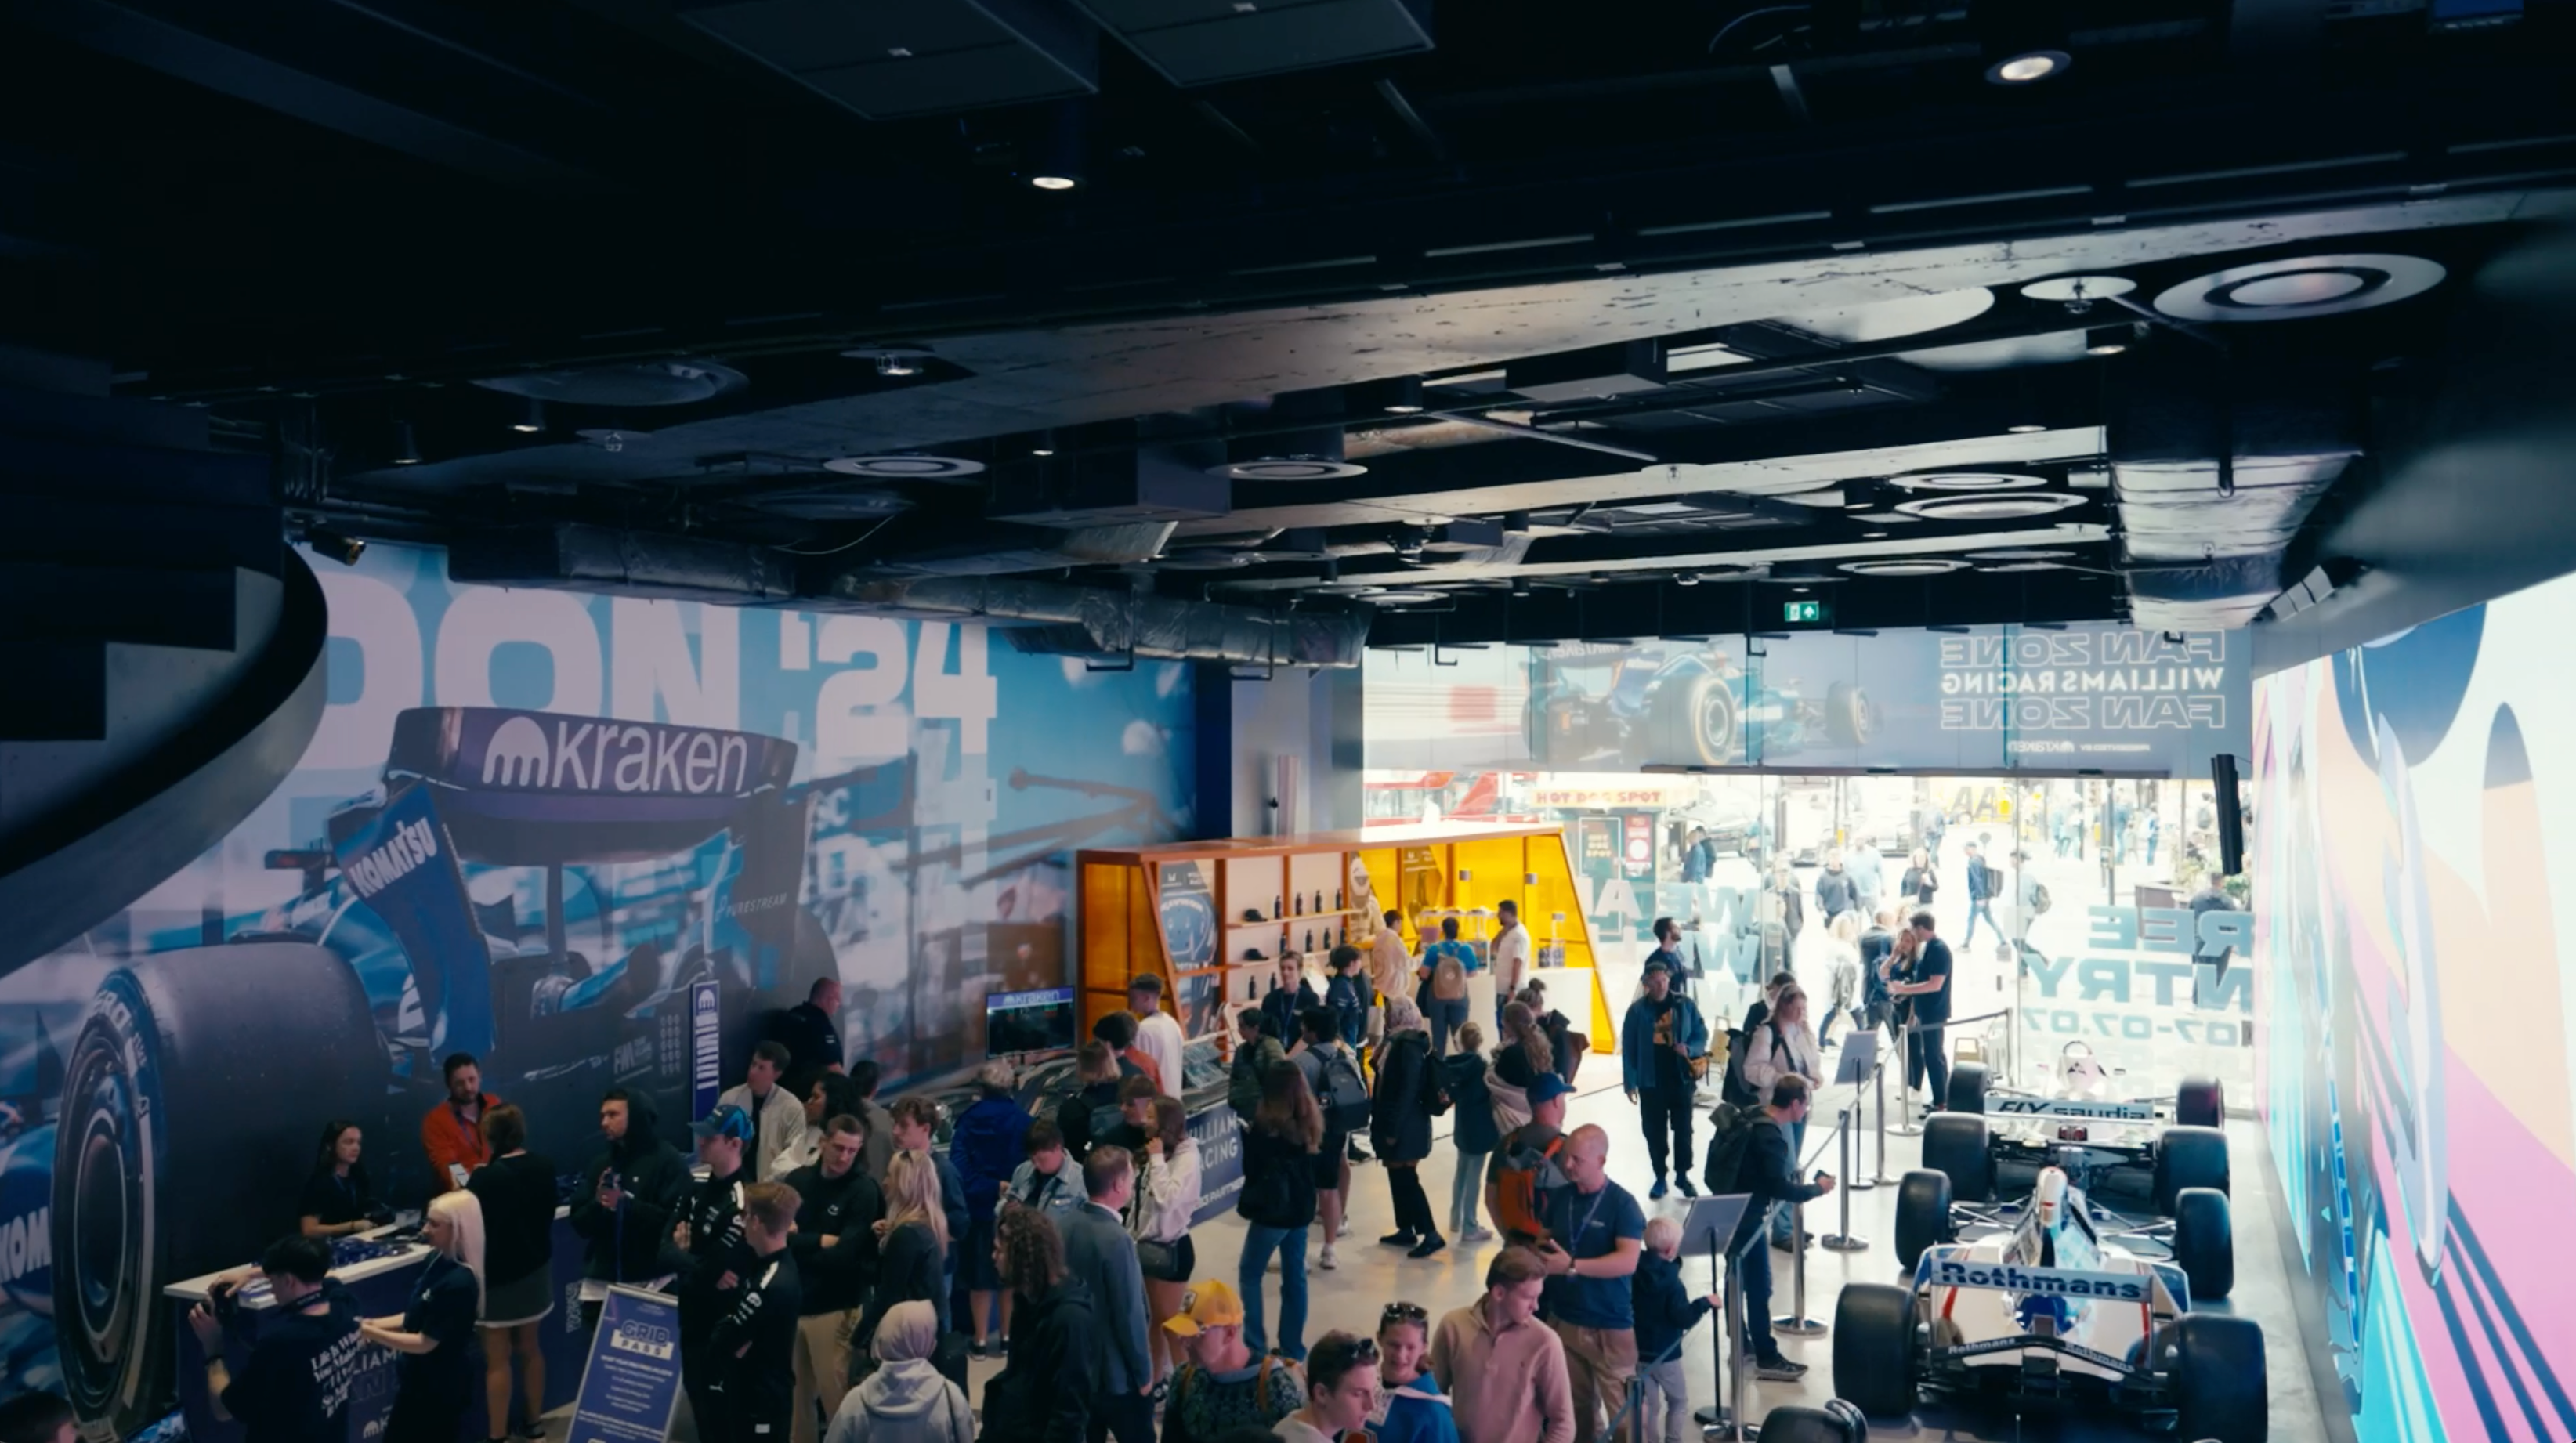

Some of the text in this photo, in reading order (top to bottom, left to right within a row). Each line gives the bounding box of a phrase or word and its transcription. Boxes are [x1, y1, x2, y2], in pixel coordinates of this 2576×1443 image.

[552, 721, 747, 794] kraken
[1536, 791, 1570, 804] HOT
[1617, 791, 1662, 804] SPOT
[349, 816, 437, 898] KOMATSU
[1189, 1110, 1238, 1145] ILLIAM
[1199, 1137, 1238, 1171] ACING
[1941, 1261, 2142, 1299] Rothmans
[621, 1319, 670, 1344] GRID
